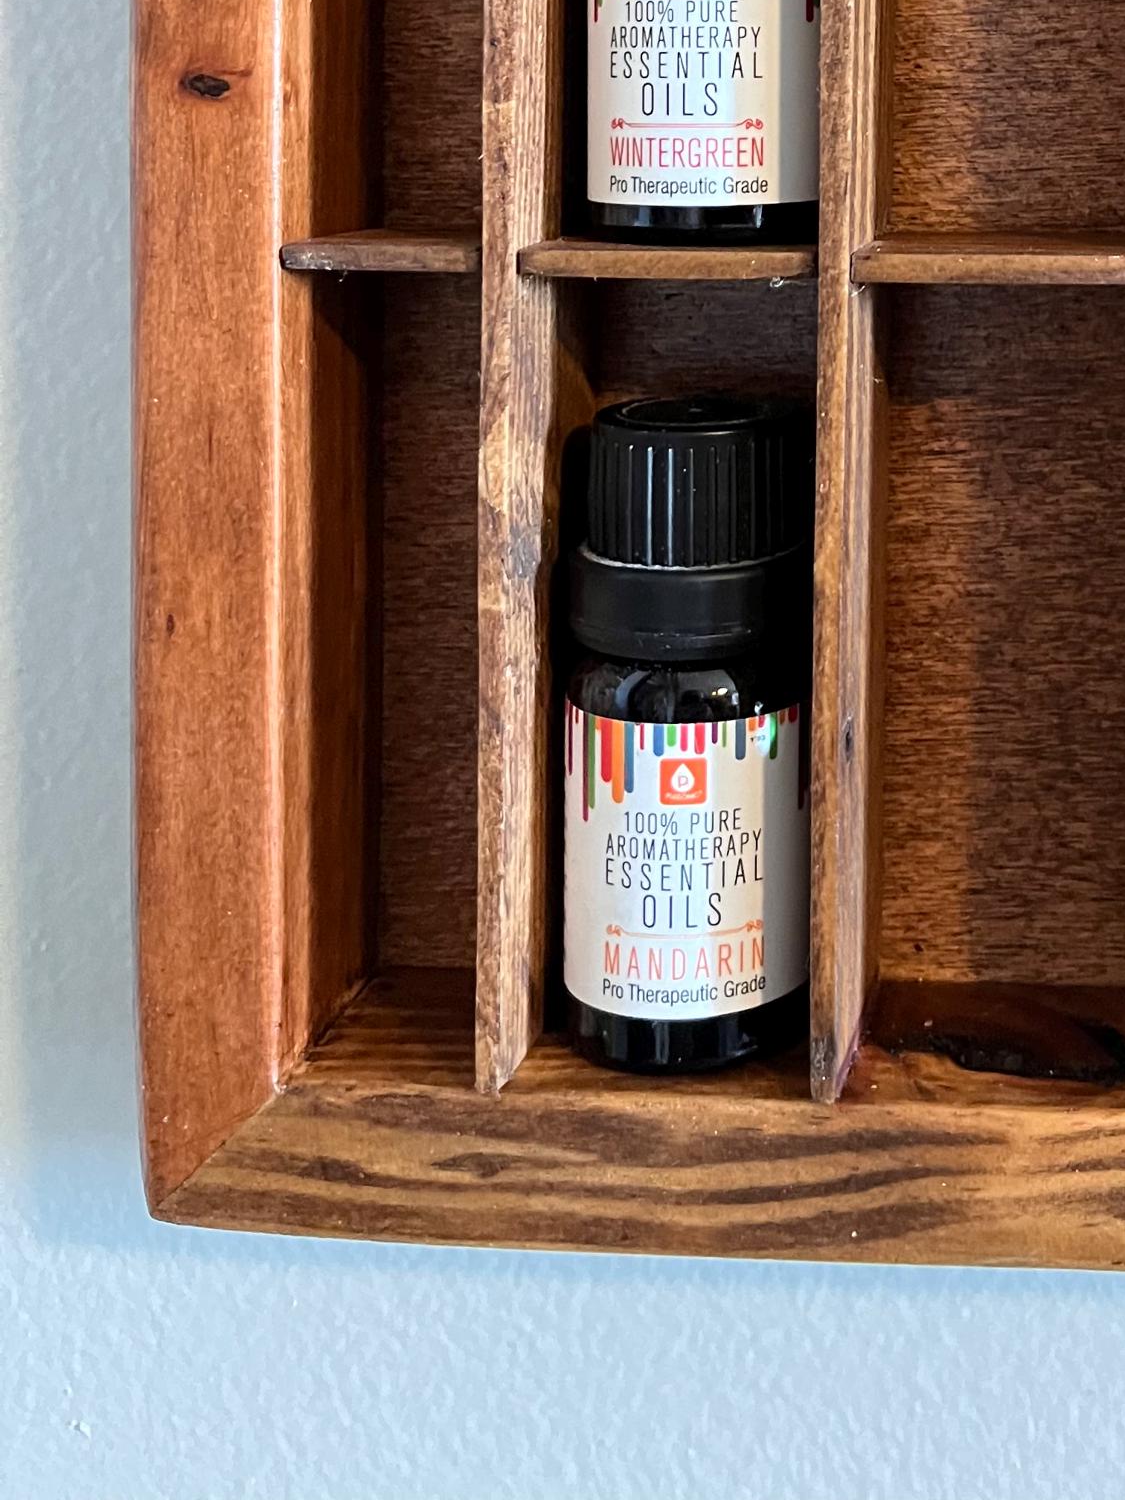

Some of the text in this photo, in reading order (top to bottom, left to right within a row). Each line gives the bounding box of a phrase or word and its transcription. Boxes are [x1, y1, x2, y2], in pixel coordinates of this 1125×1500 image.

[686, 0, 739, 23] PURE
[610, 26, 762, 48] AROMATHERAPY
[610, 51, 763, 79] ESSENTIAL
[641, 82, 719, 117] OILS
[610, 136, 765, 168] WINTERGREEN
[609, 176, 769, 198] Pro Therapeutic Grade
[624, 808, 742, 836] 100% PURE
[605, 828, 762, 861] AROMATHERAPY
[605, 855, 764, 892] ESSENTIAL
[642, 892, 722, 929] OILS
[604, 935, 765, 980] MANDARIN
[602, 975, 766, 1006] Pro Therapeutic Grade
